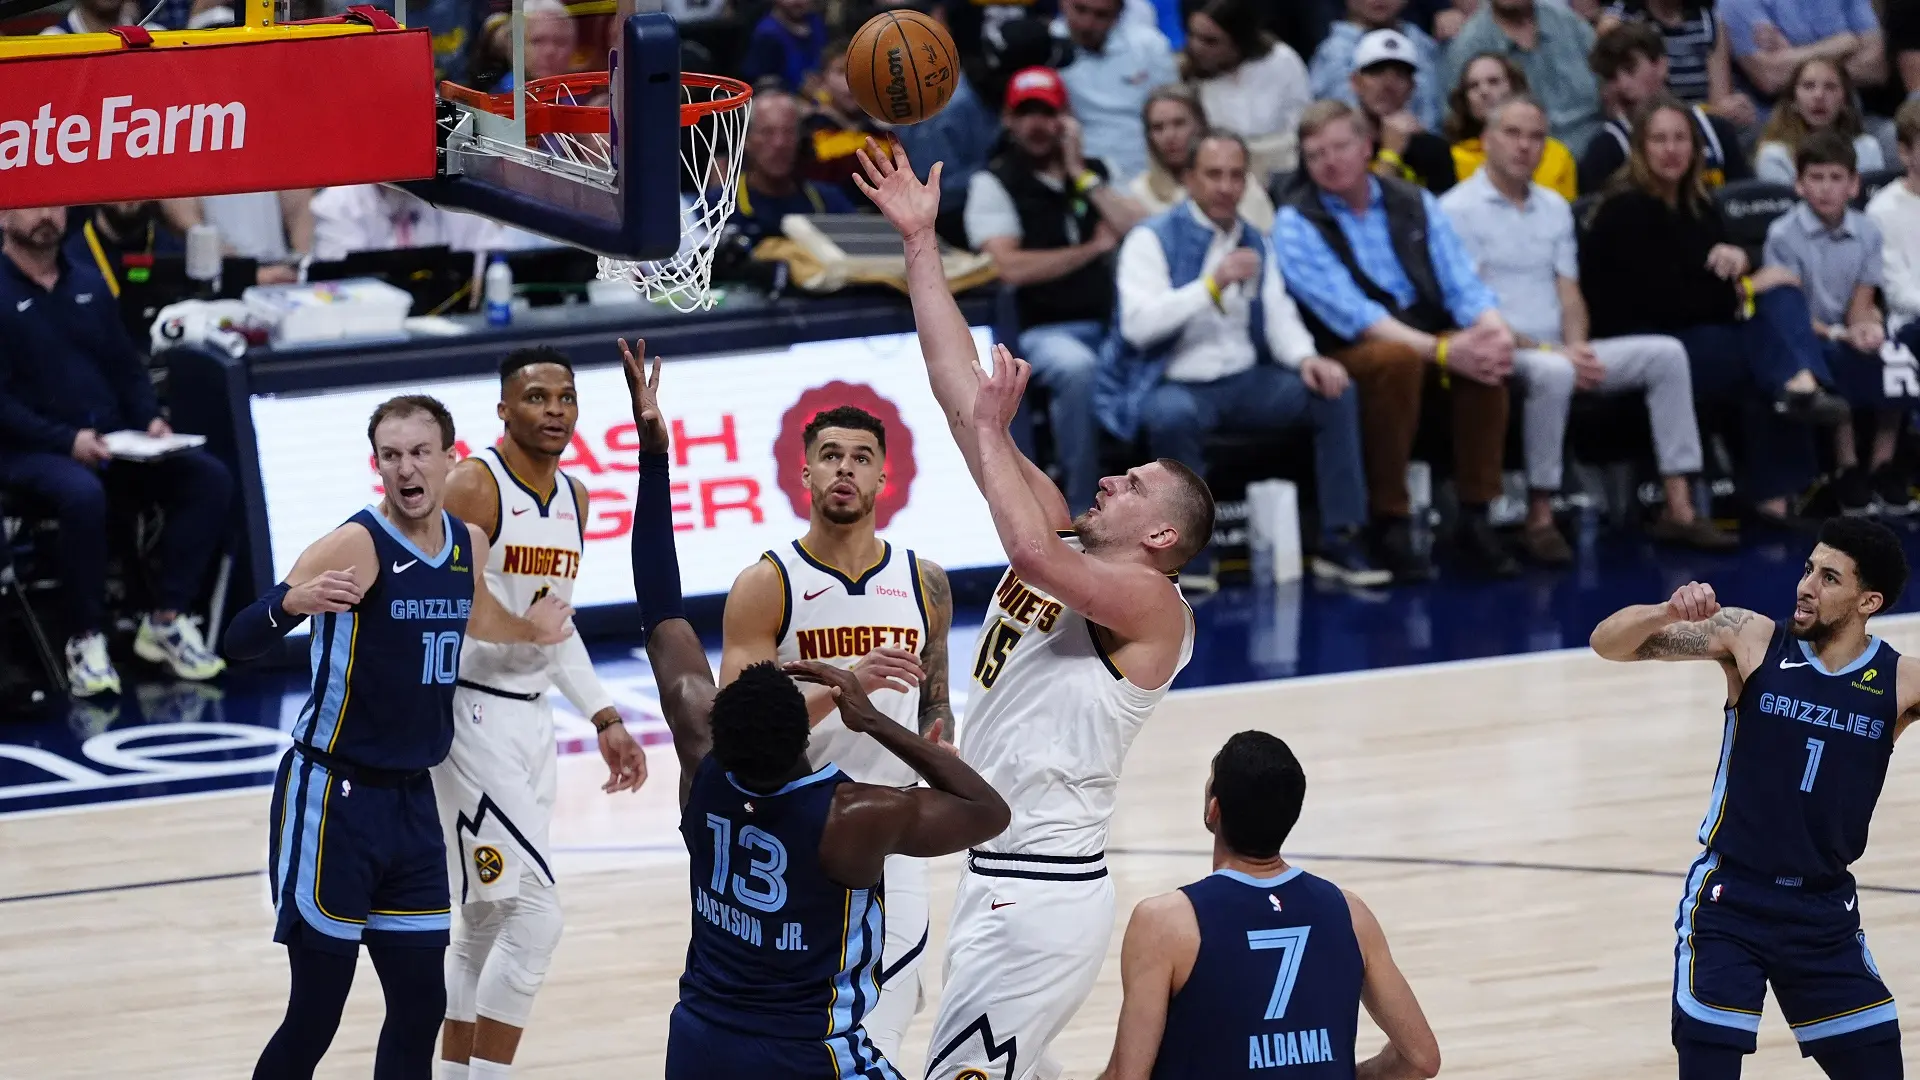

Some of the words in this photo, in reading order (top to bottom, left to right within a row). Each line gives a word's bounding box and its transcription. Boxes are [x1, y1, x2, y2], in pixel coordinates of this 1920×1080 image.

[886, 47, 912, 118] Wilson
[97, 94, 246, 159] Farm
[503, 545, 581, 580] NUGGETS
[875, 585, 908, 598] ibotta
[421, 631, 460, 685] 10
[796, 626, 919, 660] NUGGETS
[973, 617, 1023, 690] 15
[1851, 681, 1883, 695] Robinhood
[1760, 692, 1885, 740] GRIZZLIES
[1799, 737, 1825, 793] 1
[706, 812, 788, 913] 13
[697, 886, 762, 947] JACKSON
[775, 922, 808, 950] JR.
[1247, 925, 1312, 1020] 7
[1249, 1028, 1333, 1069] ALDAMA
